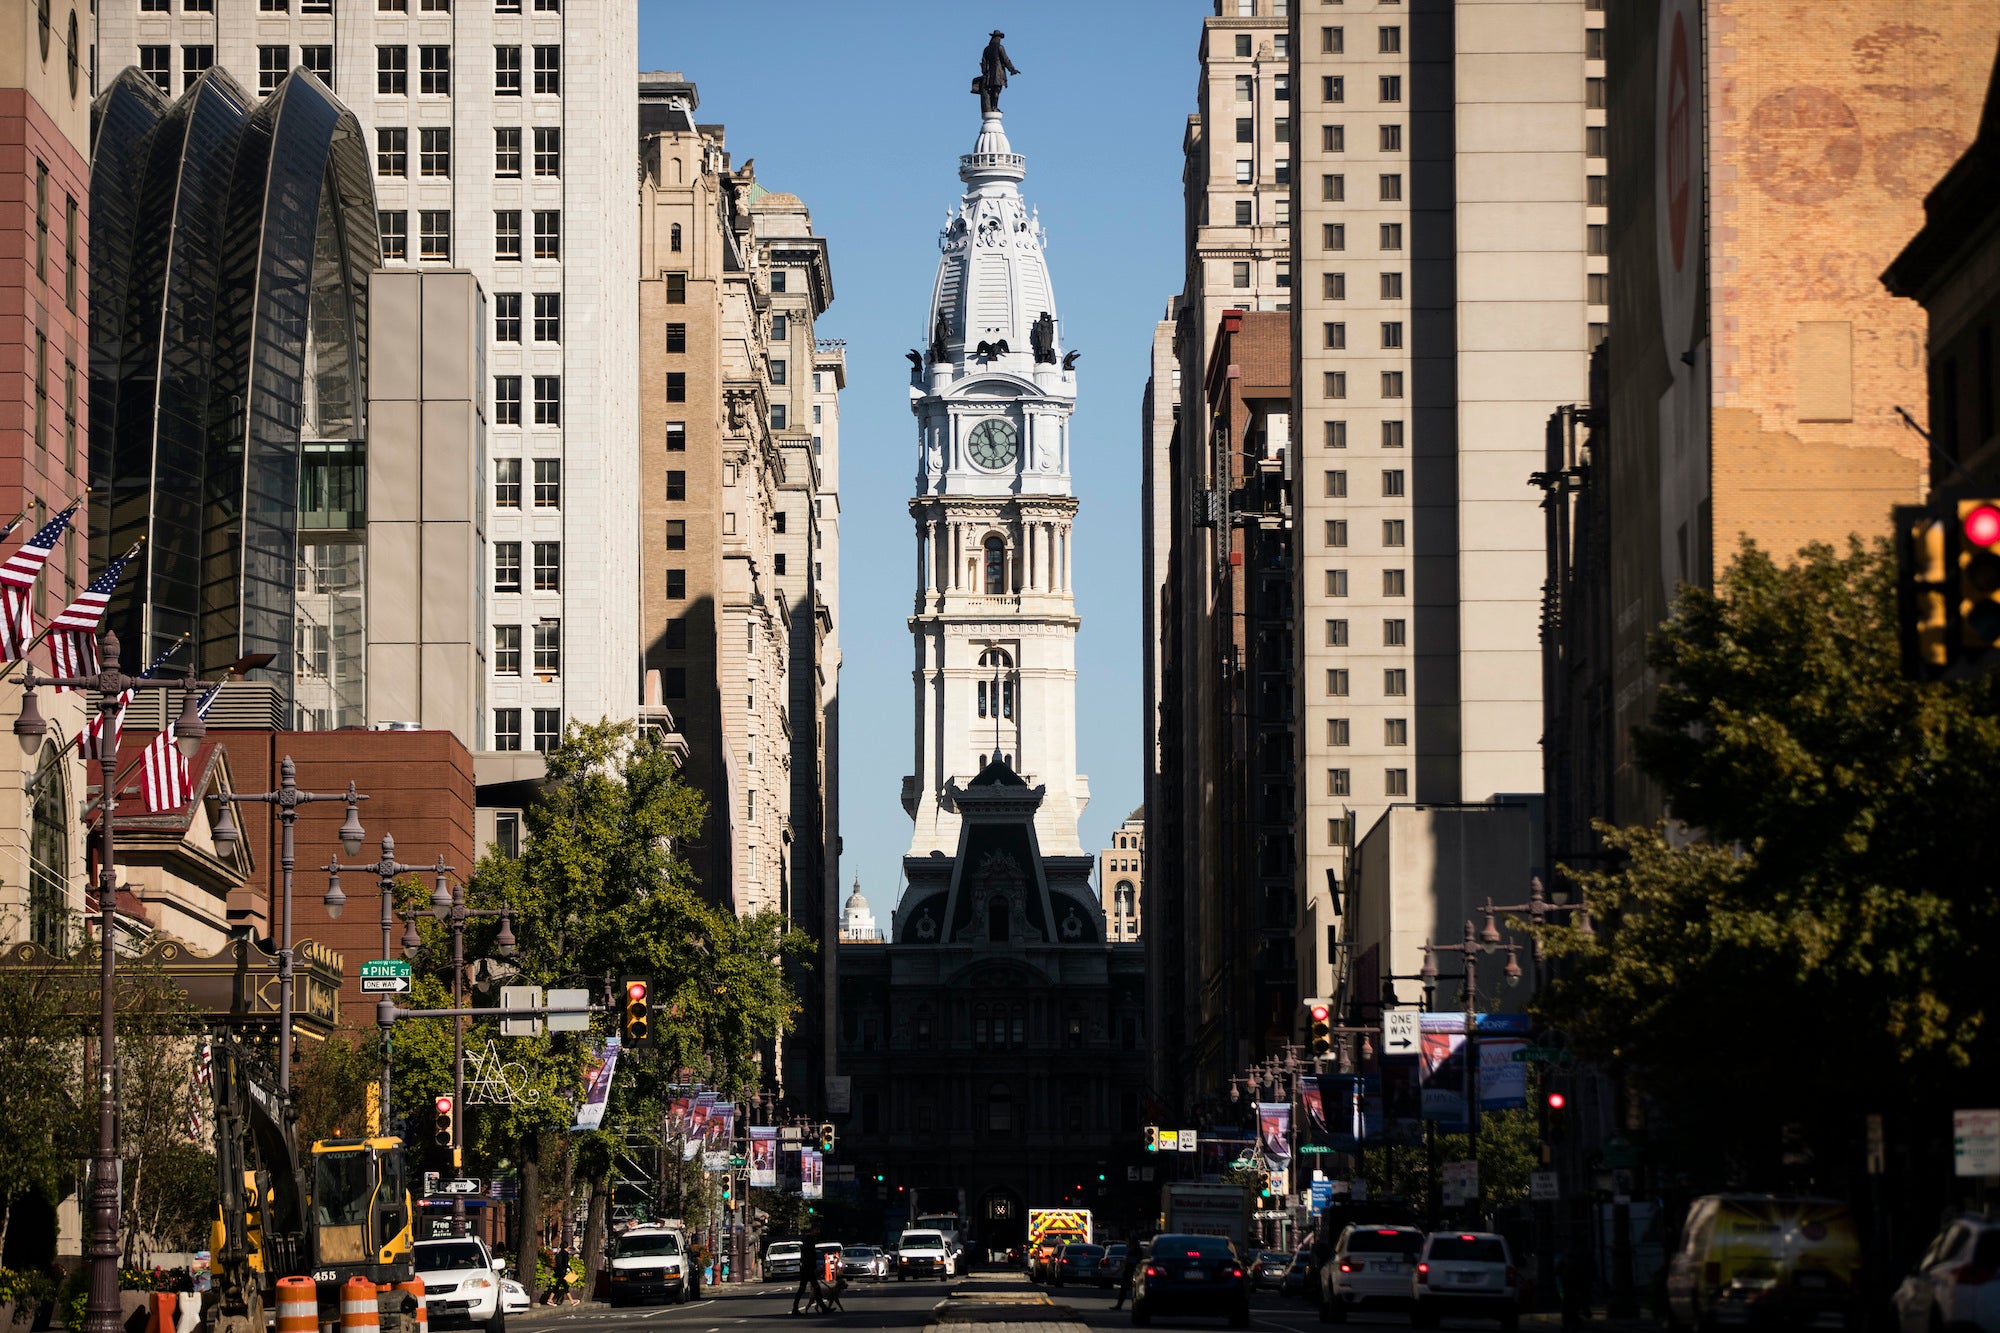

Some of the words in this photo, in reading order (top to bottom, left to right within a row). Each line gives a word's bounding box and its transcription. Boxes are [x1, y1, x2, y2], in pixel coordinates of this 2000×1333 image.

[371, 966, 396, 976] PINE
[1391, 1014, 1412, 1024] ONE
[1390, 1025, 1413, 1036] WAY
[432, 1220, 450, 1228] Free
[312, 1270, 327, 1282] 455
